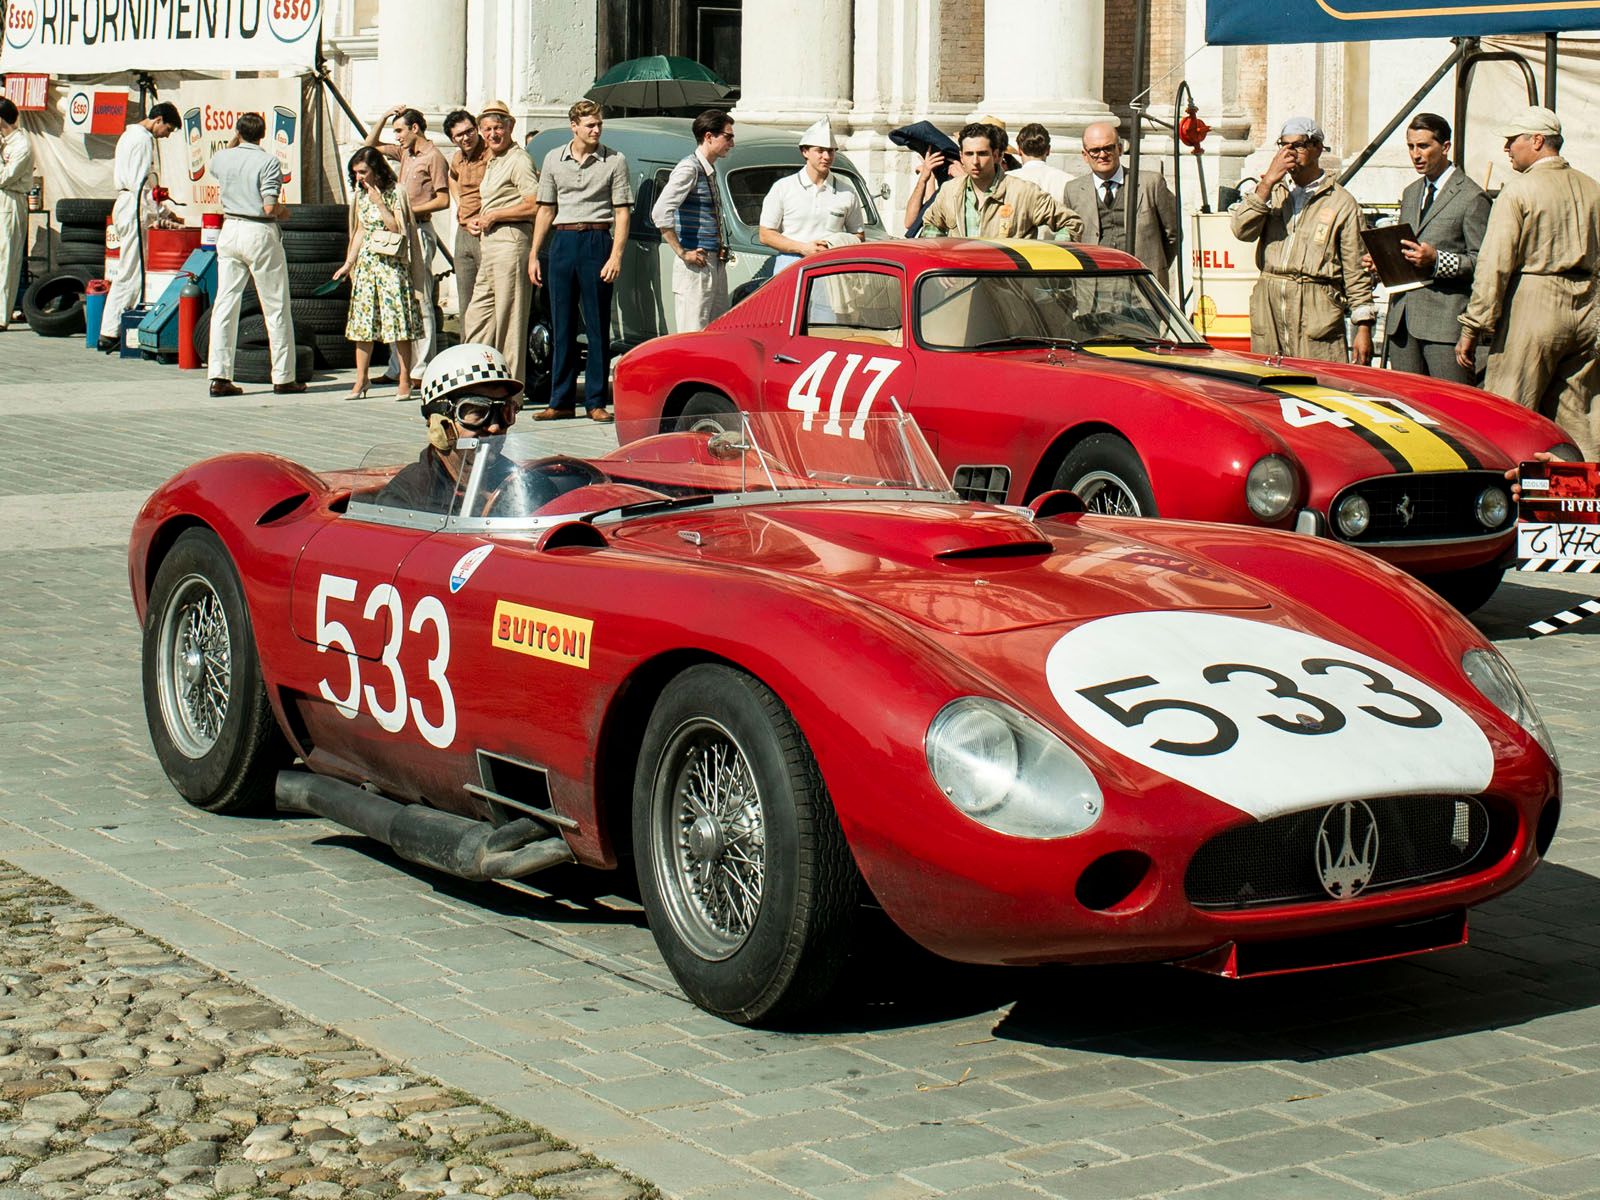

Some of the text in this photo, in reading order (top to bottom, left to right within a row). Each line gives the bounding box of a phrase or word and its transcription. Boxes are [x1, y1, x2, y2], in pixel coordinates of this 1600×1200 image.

[1192, 250, 1235, 268] SHELL
[787, 351, 901, 440] 417
[1279, 397, 1441, 428] 417
[1521, 525, 1553, 553] 2
[498, 613, 586, 659] BUITONI
[315, 573, 457, 749] 533
[1075, 657, 1442, 757] 533
